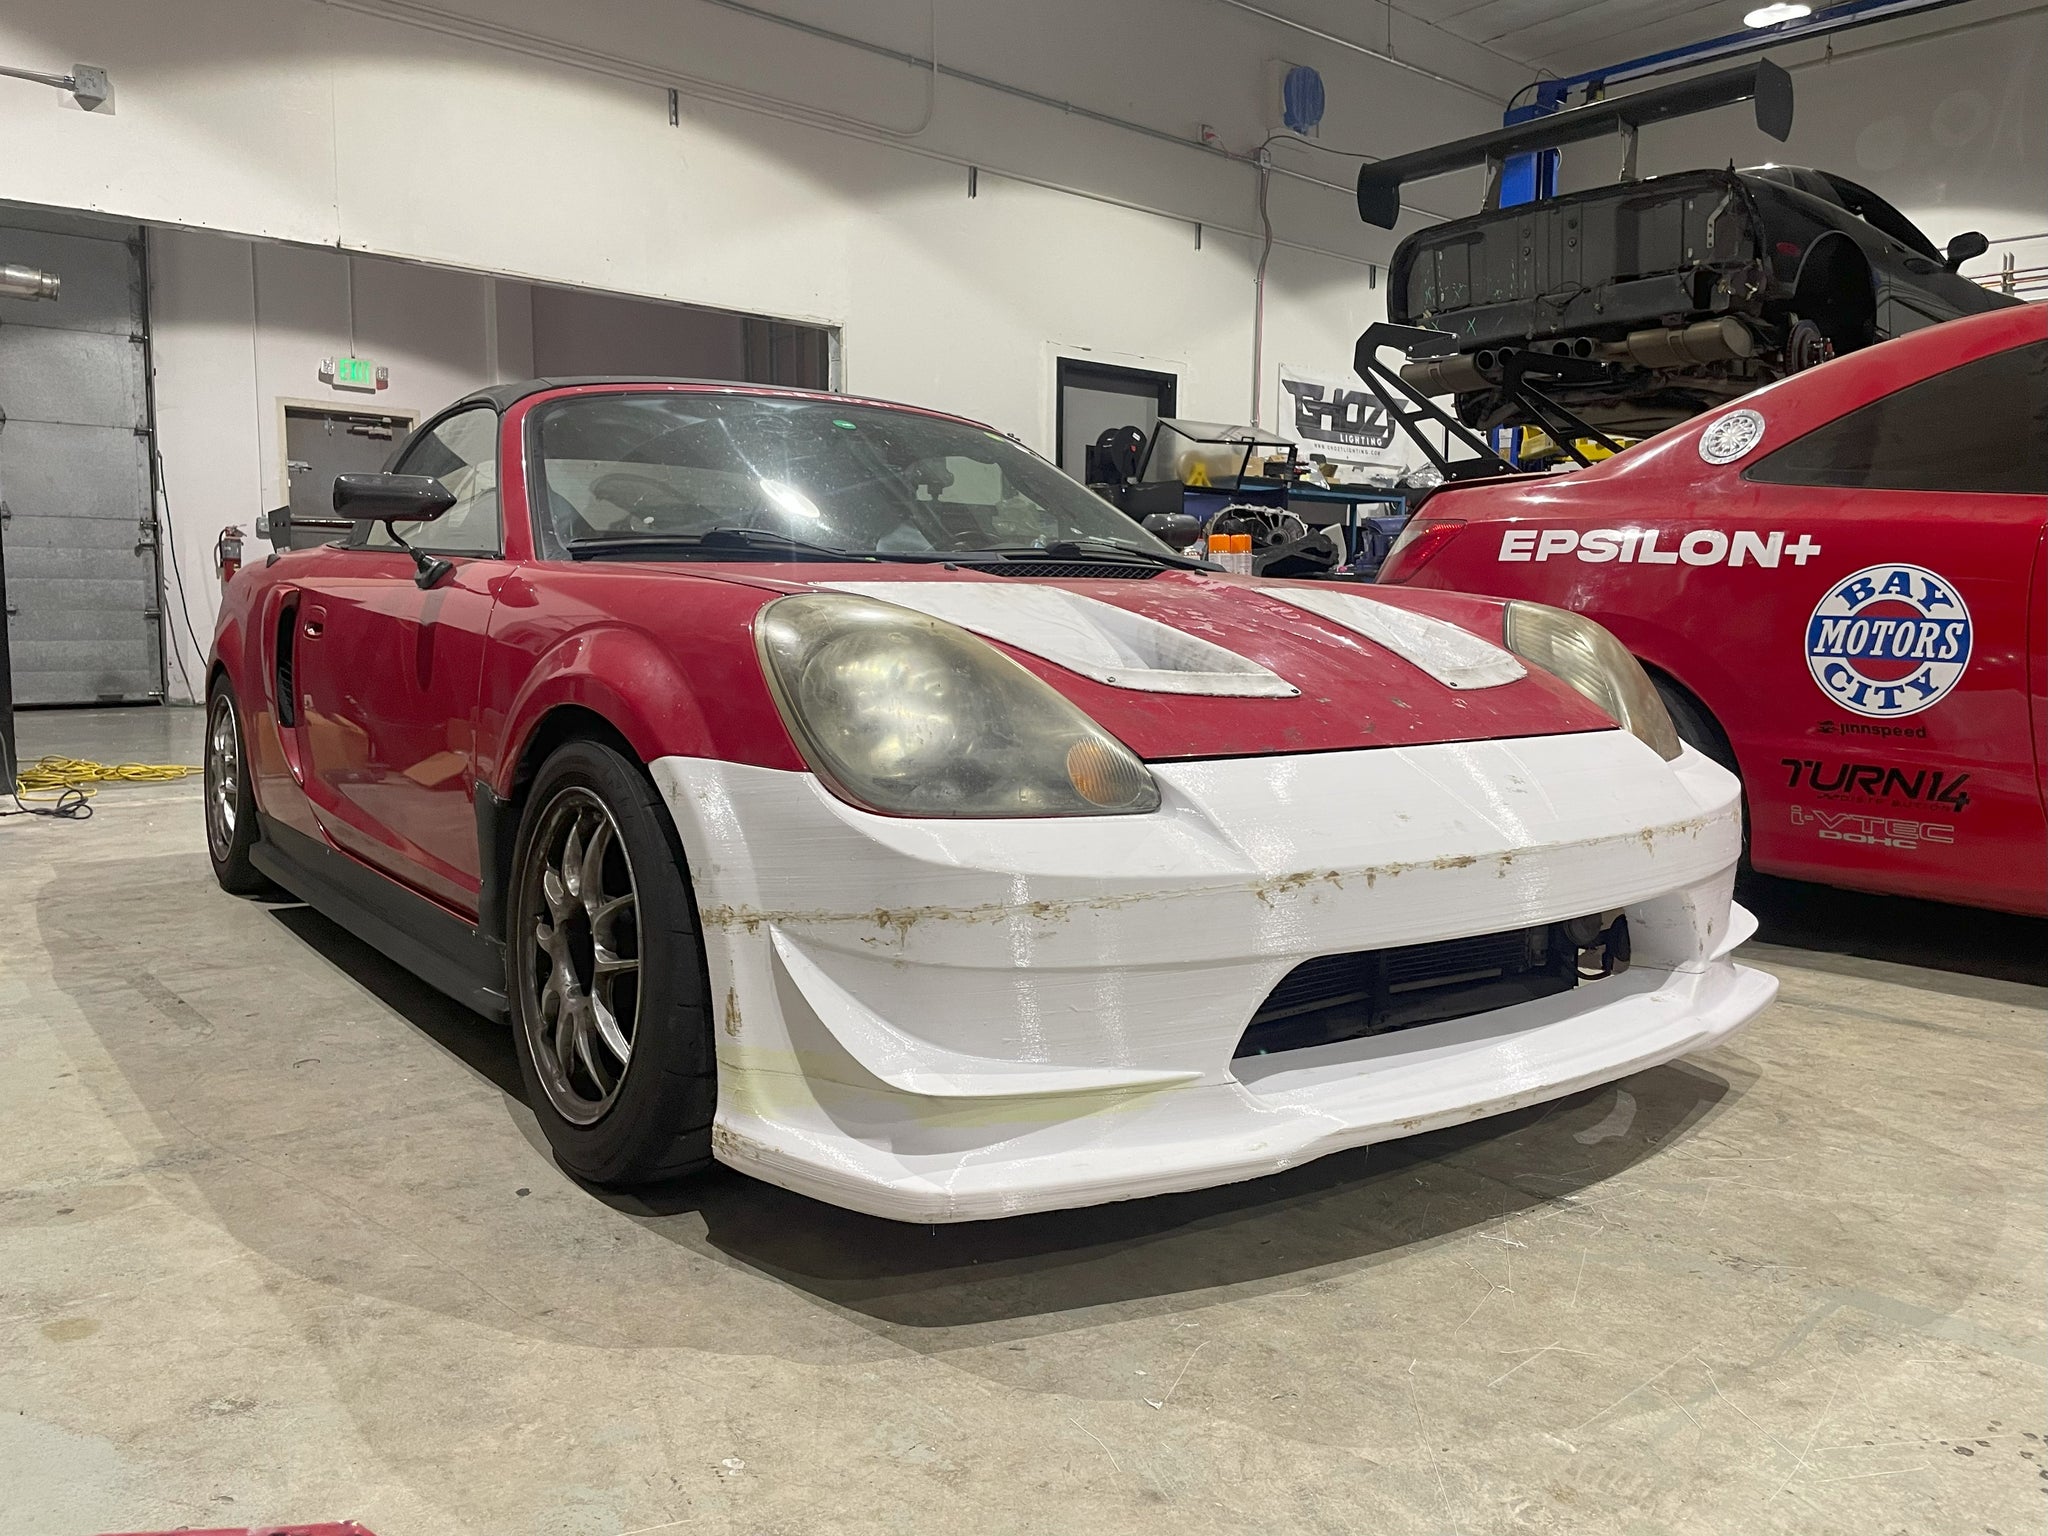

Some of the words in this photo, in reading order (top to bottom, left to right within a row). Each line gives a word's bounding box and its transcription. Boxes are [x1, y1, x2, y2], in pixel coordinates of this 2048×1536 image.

[339, 358, 371, 385] EXIT
[1340, 433, 1383, 447] LIGHTING
[1498, 529, 1822, 568] EPSILON+
[1835, 571, 1954, 612] BAY
[1813, 619, 1965, 660] MOTORS
[1823, 662, 1939, 709] CITY
[1839, 723, 1927, 739] jinnspeed
[1790, 805, 1955, 844] i-VTEC
[1818, 829, 1917, 850] DOHC
